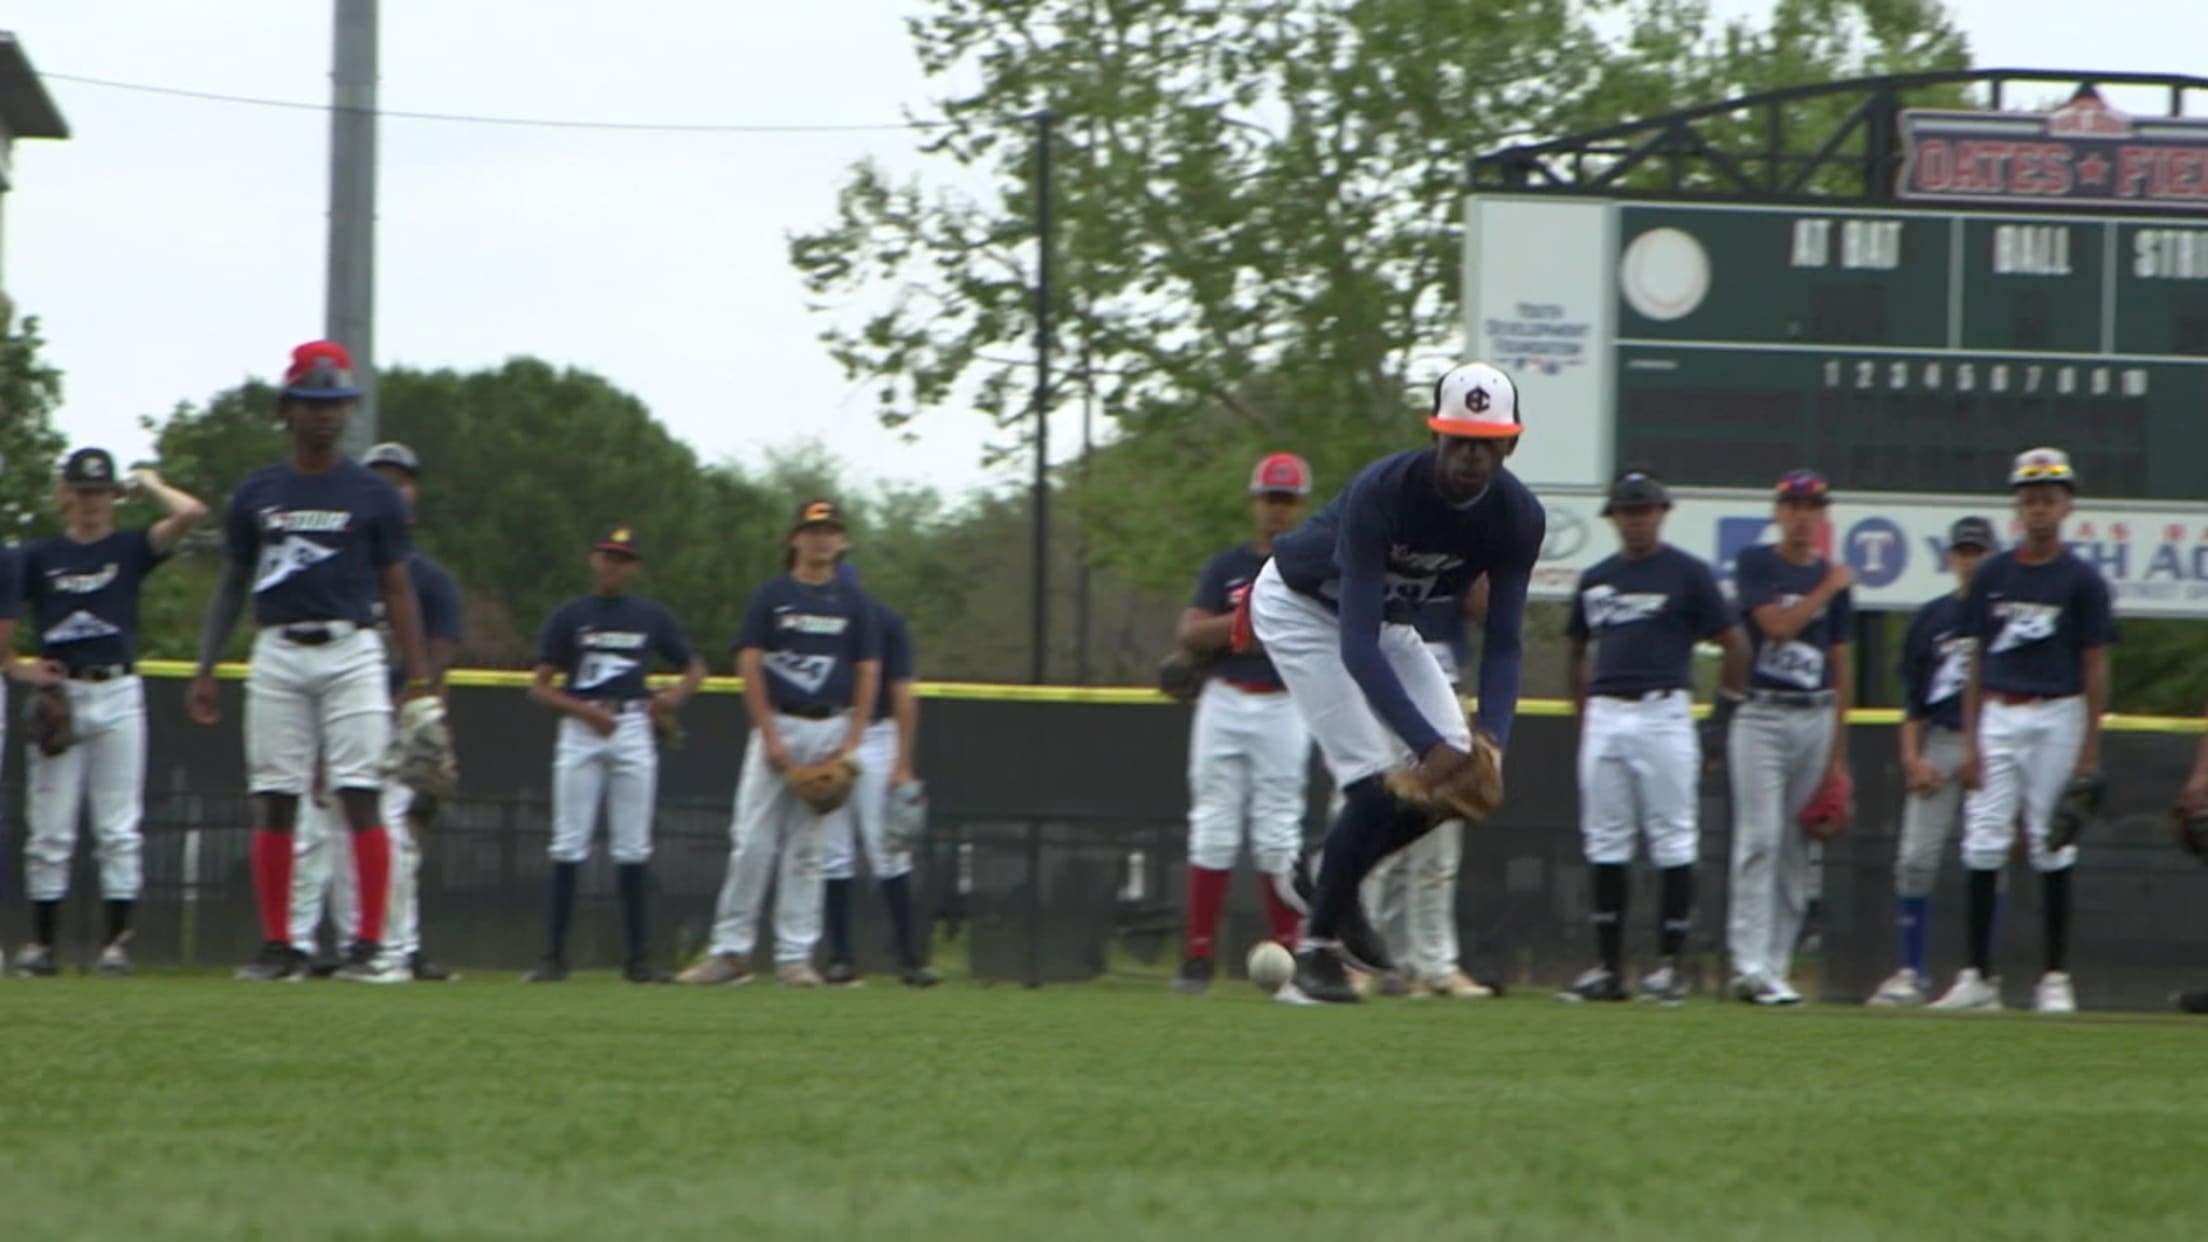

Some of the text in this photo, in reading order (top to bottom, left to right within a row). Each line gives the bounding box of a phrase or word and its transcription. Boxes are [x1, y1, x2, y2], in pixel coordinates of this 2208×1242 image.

[1918, 139, 2208, 198] OATES FIE
[1824, 361, 1840, 387] 1
[1856, 361, 1874, 388] 2
[1889, 361, 1907, 388] 3
[1923, 362, 1941, 388] 4
[1957, 363, 1975, 391] 5
[1990, 364, 2008, 392] 6
[2024, 365, 2042, 392] 7
[2057, 366, 2076, 393] 8
[2091, 368, 2109, 394] 9
[1854, 528, 1893, 573] T
